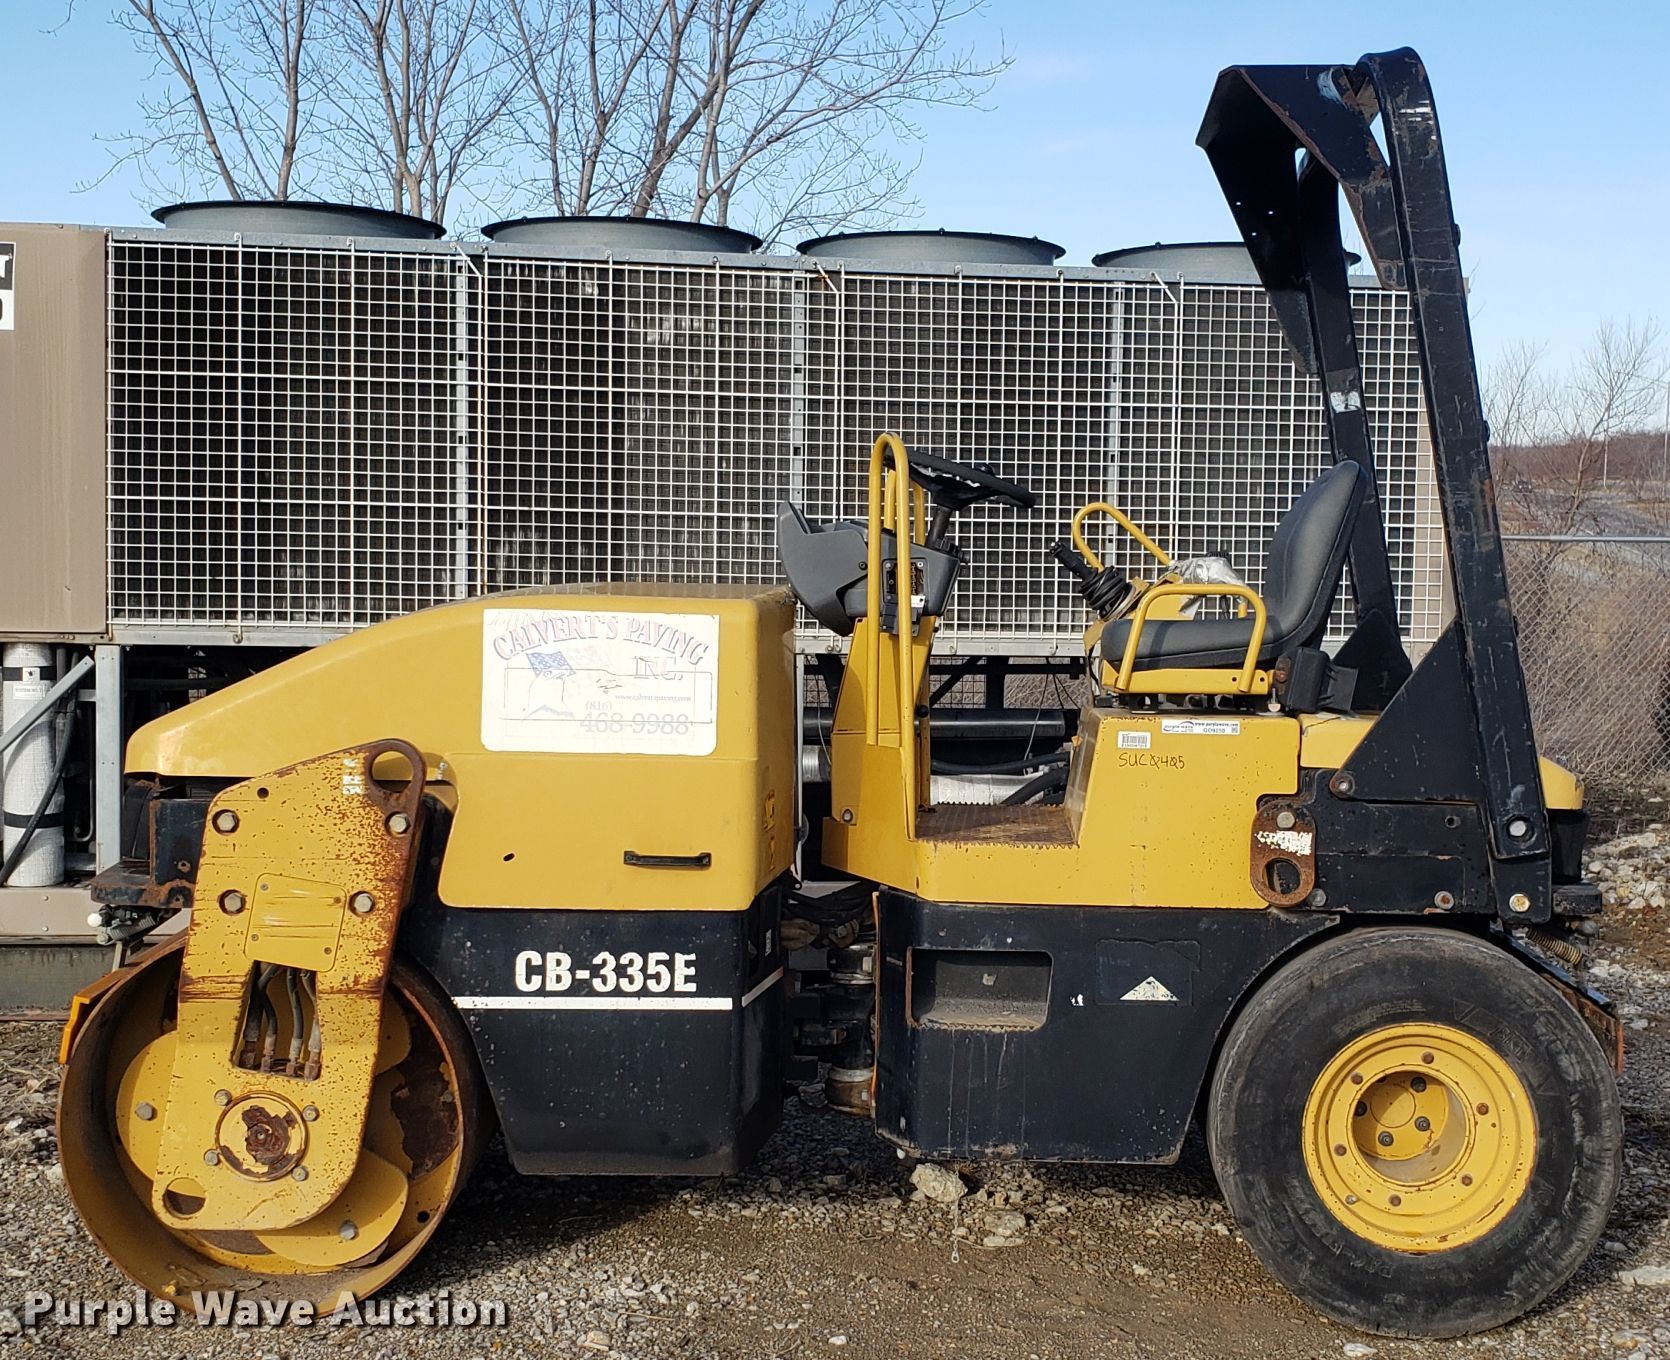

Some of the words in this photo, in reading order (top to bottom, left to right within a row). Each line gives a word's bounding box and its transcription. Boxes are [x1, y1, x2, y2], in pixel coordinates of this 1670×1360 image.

[493, 614, 619, 661] CALVERT'S
[622, 616, 709, 666] PAVING
[579, 712, 690, 736] 468-9988
[514, 950, 697, 993] CB-335E
